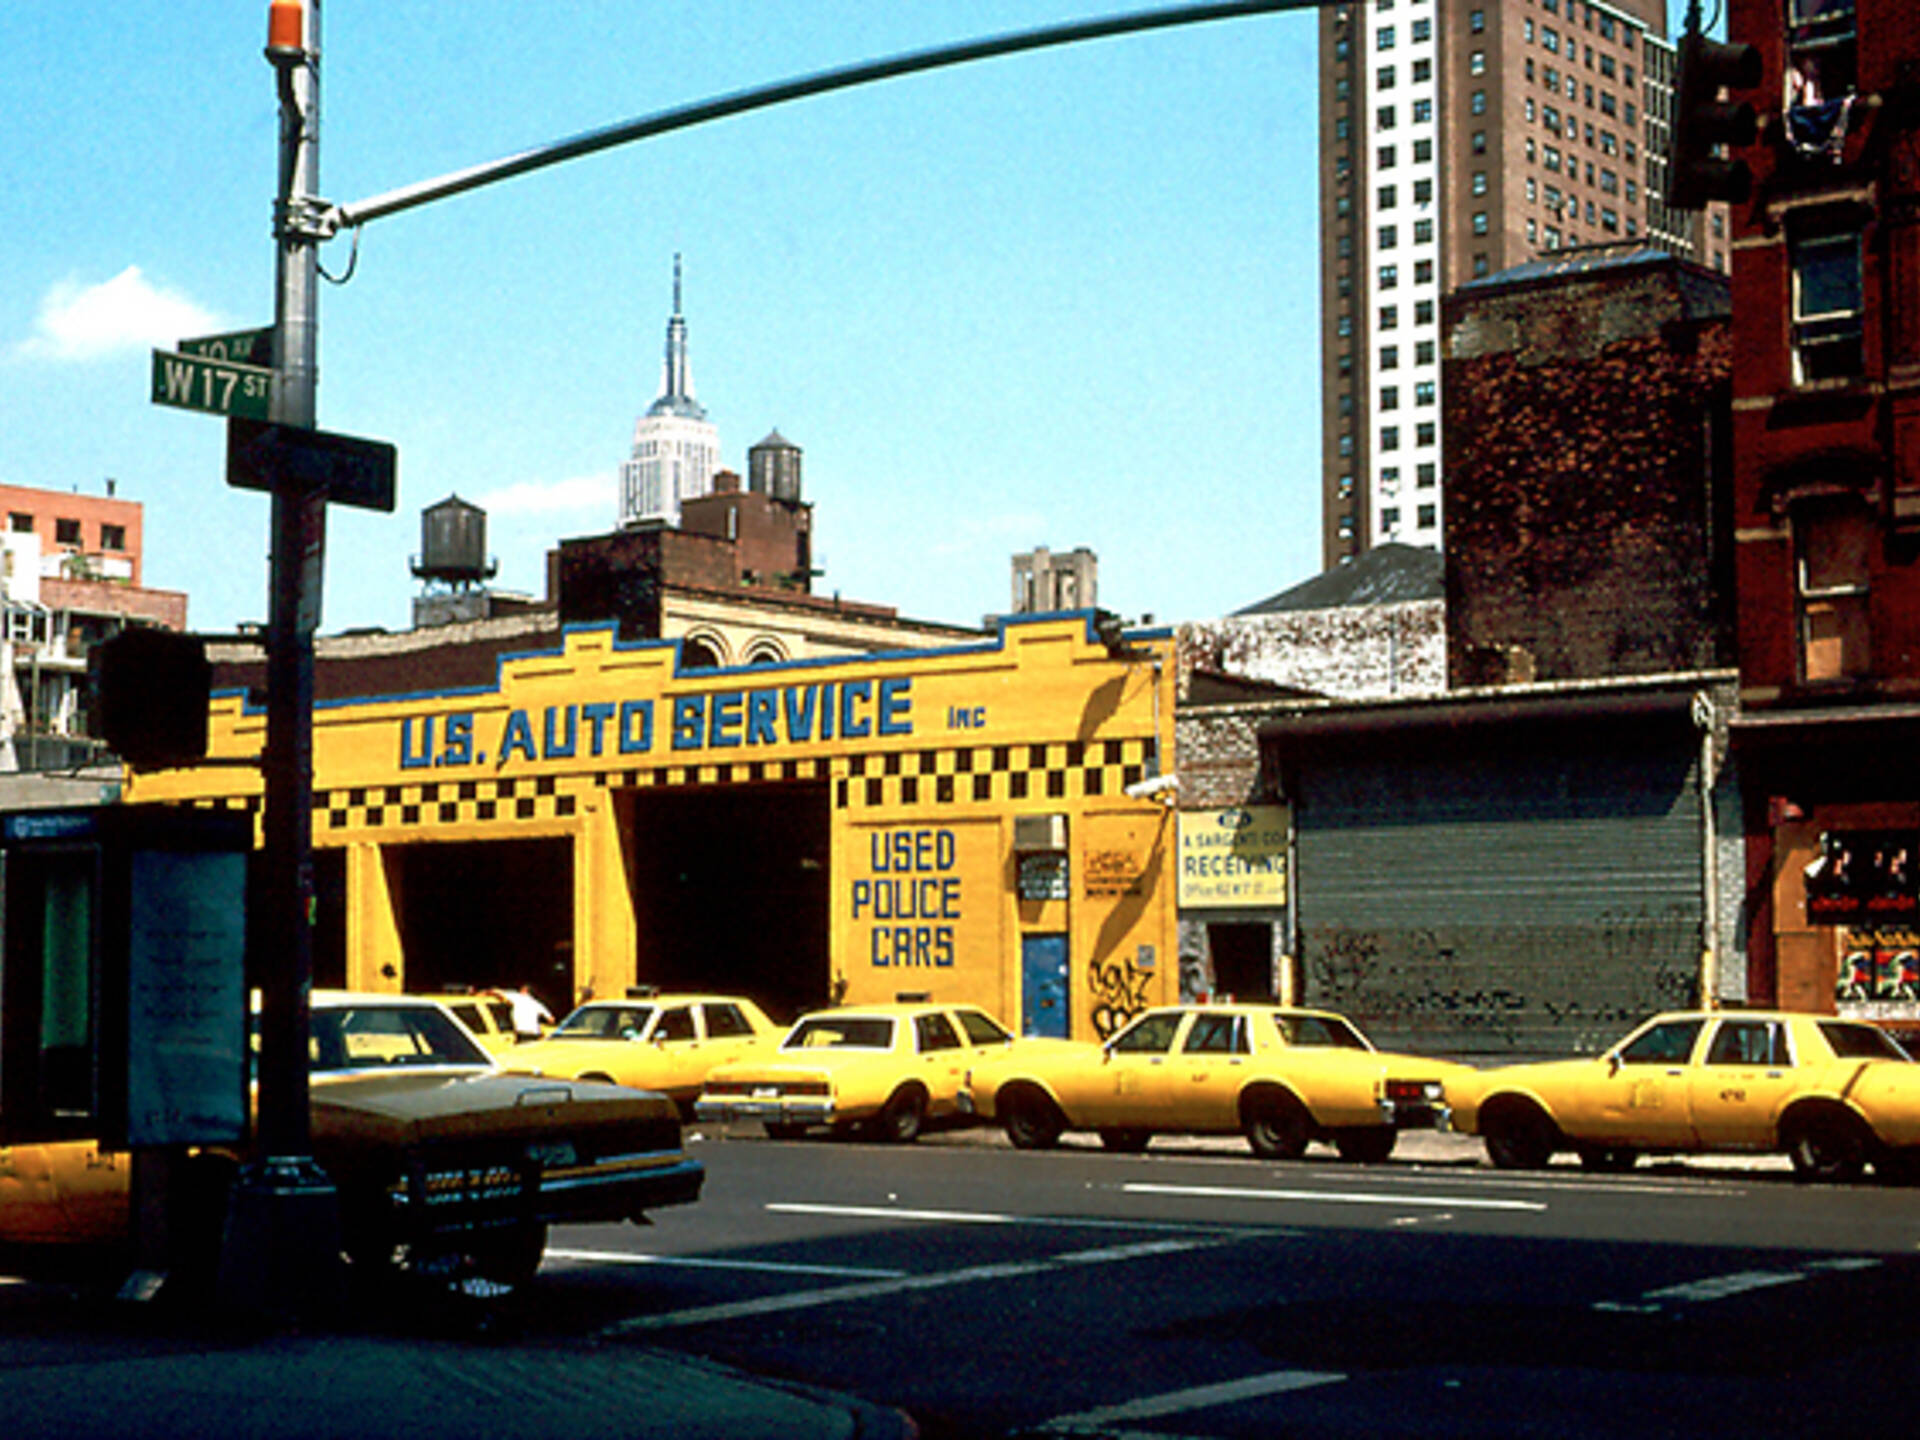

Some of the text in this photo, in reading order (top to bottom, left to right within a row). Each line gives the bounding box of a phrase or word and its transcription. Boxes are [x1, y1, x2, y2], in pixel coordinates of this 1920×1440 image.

[164, 359, 268, 410] W 17 ST
[400, 711, 485, 770] U.S.
[496, 699, 654, 771] AUTO
[671, 676, 913, 751] SERVICE
[871, 829, 955, 873] USED
[852, 877, 962, 920] POLICE
[871, 925, 955, 968] CARS
